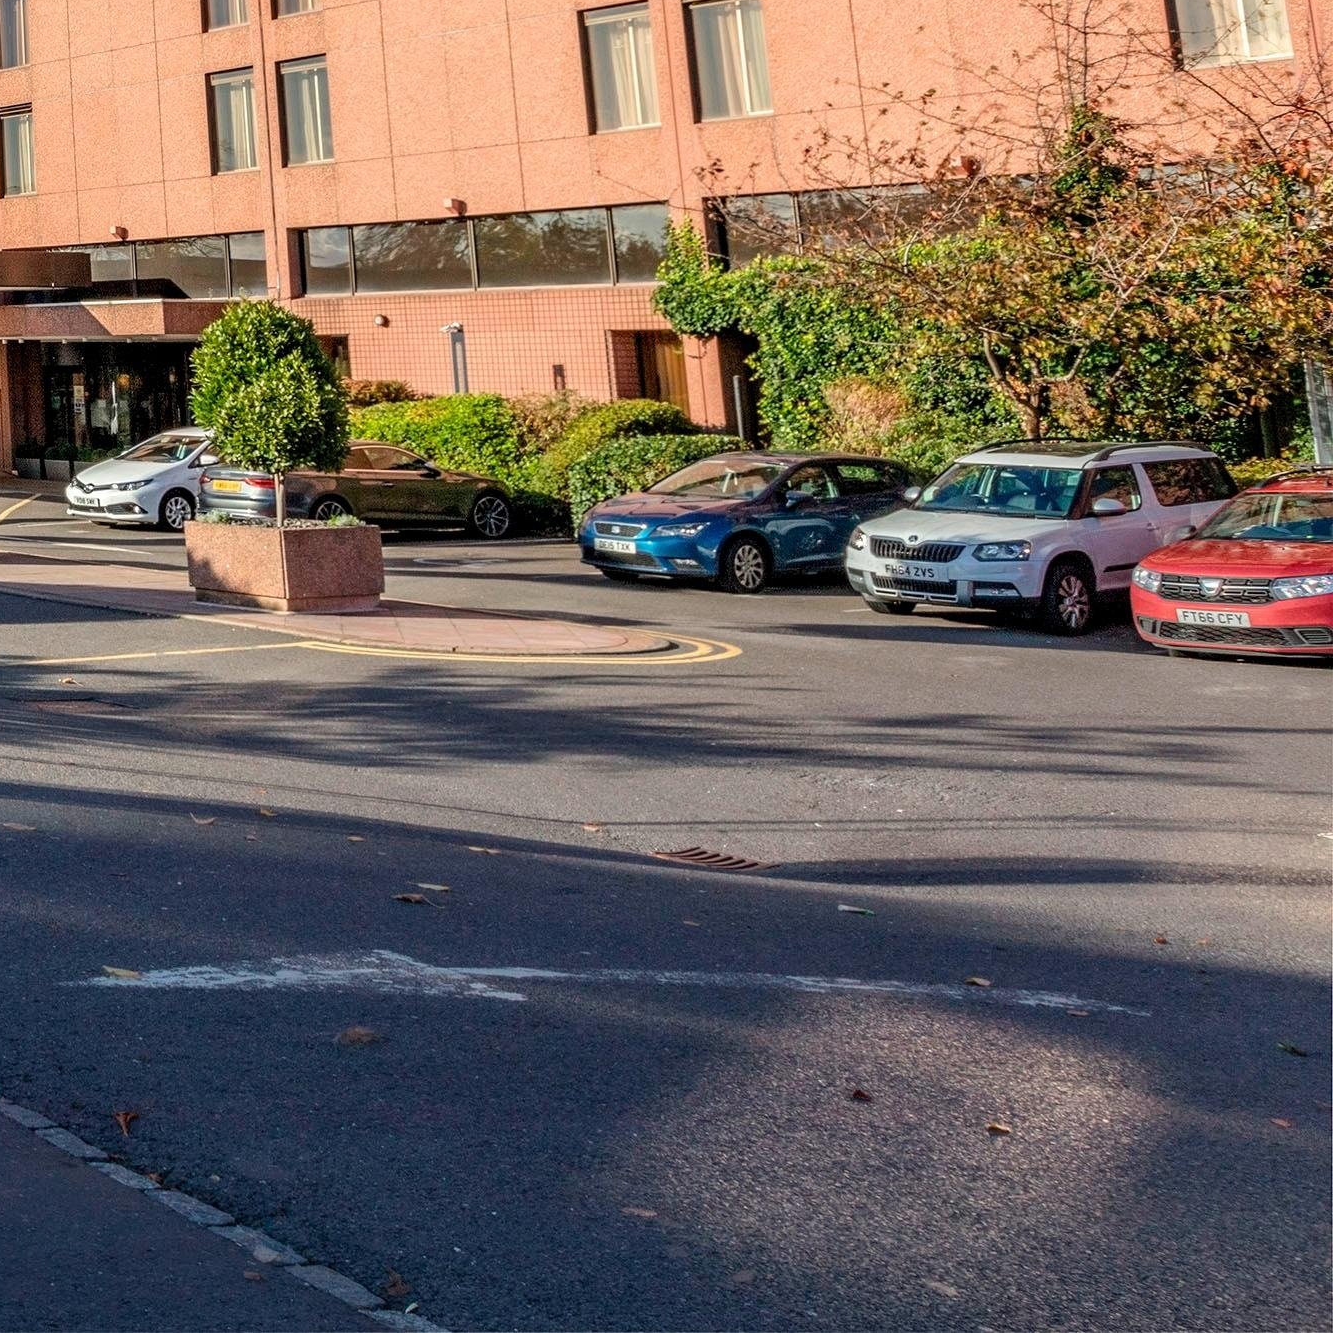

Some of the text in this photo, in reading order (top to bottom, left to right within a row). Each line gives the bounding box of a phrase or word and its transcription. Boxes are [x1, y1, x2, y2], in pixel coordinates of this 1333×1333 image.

[885, 564, 935, 578] FH64 ZVS
[1182, 611, 1242, 624] FT66 CFY
